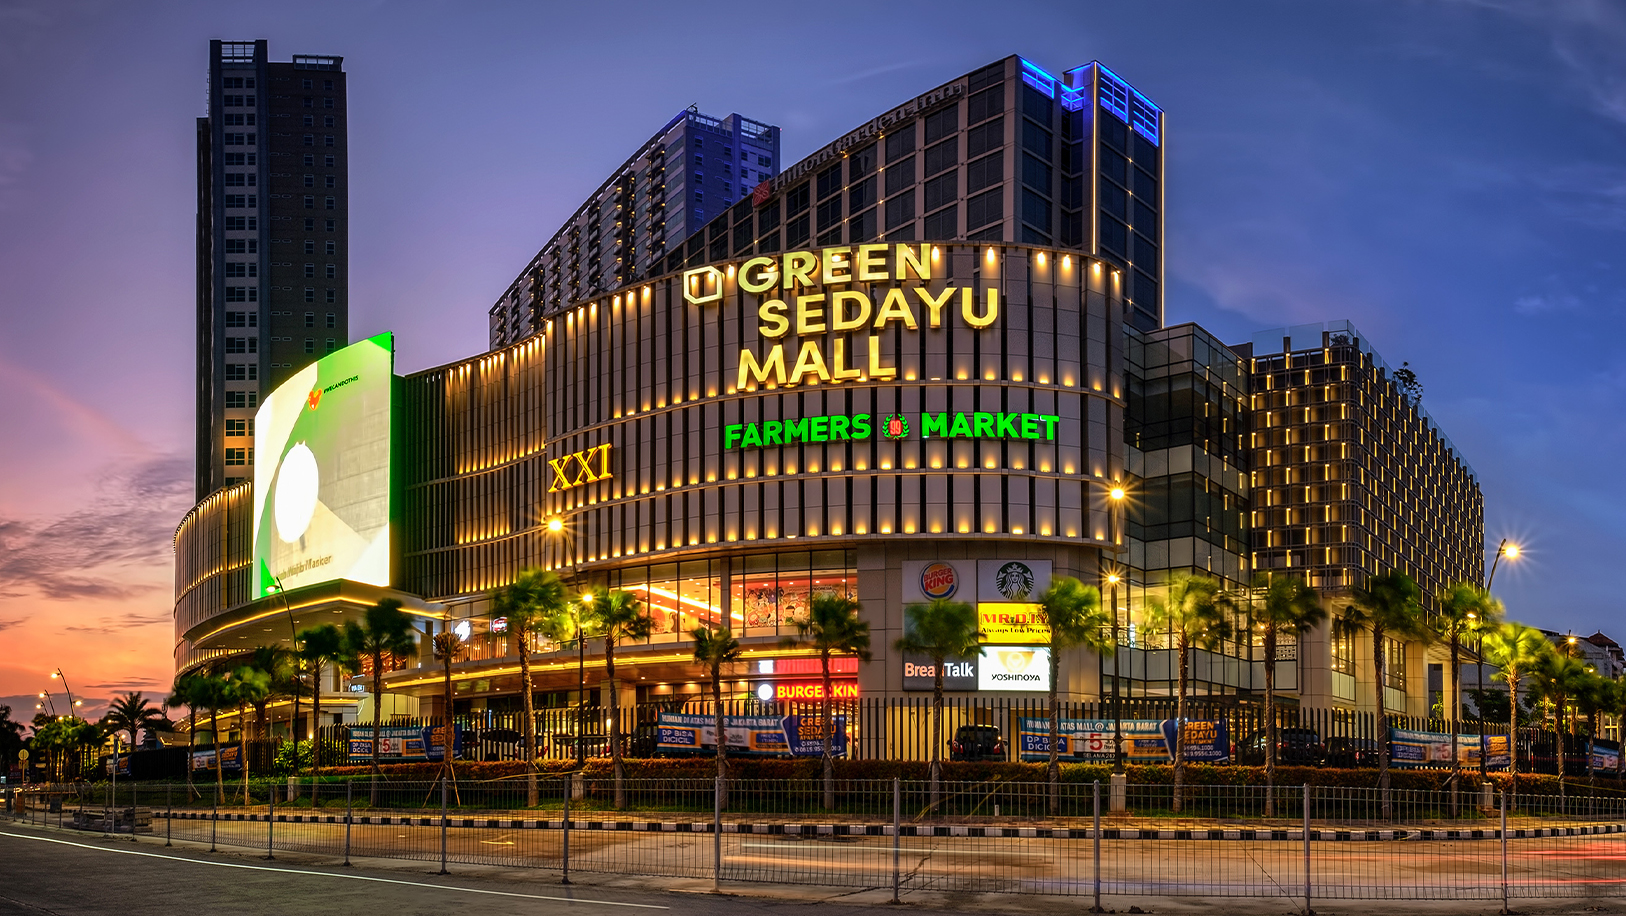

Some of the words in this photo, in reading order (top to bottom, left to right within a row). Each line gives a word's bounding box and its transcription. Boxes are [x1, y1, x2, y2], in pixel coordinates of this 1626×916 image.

[774, 149, 830, 191] Hilton
[831, 107, 907, 154] Garden
[737, 242, 931, 294] GREEN
[758, 286, 998, 338] SEDAYU
[736, 335, 897, 391] MALL
[724, 413, 871, 449] FARMERS
[889, 419, 902, 436] 99
[921, 411, 1060, 441] MARKET
[548, 443, 613, 493] XXI
[923, 568, 953, 582] BURGER
[924, 574, 954, 592] KING
[991, 673, 1041, 681] YOSHINOYA
[690, 716, 704, 725] ATAS
[730, 718, 757, 726] JAKARTA
[758, 719, 779, 727] BARAT
[1076, 722, 1094, 731] MALL
[1136, 722, 1158, 731] BARAT
[1184, 721, 1214, 731] REEN
[797, 726, 837, 736] SEDAU
[1184, 730, 1217, 739] EDAYU
[382, 738, 390, 752] 5
[662, 736, 691, 744] DICICIL
[1026, 735, 1040, 743] DP
[1089, 732, 1103, 751] 5
